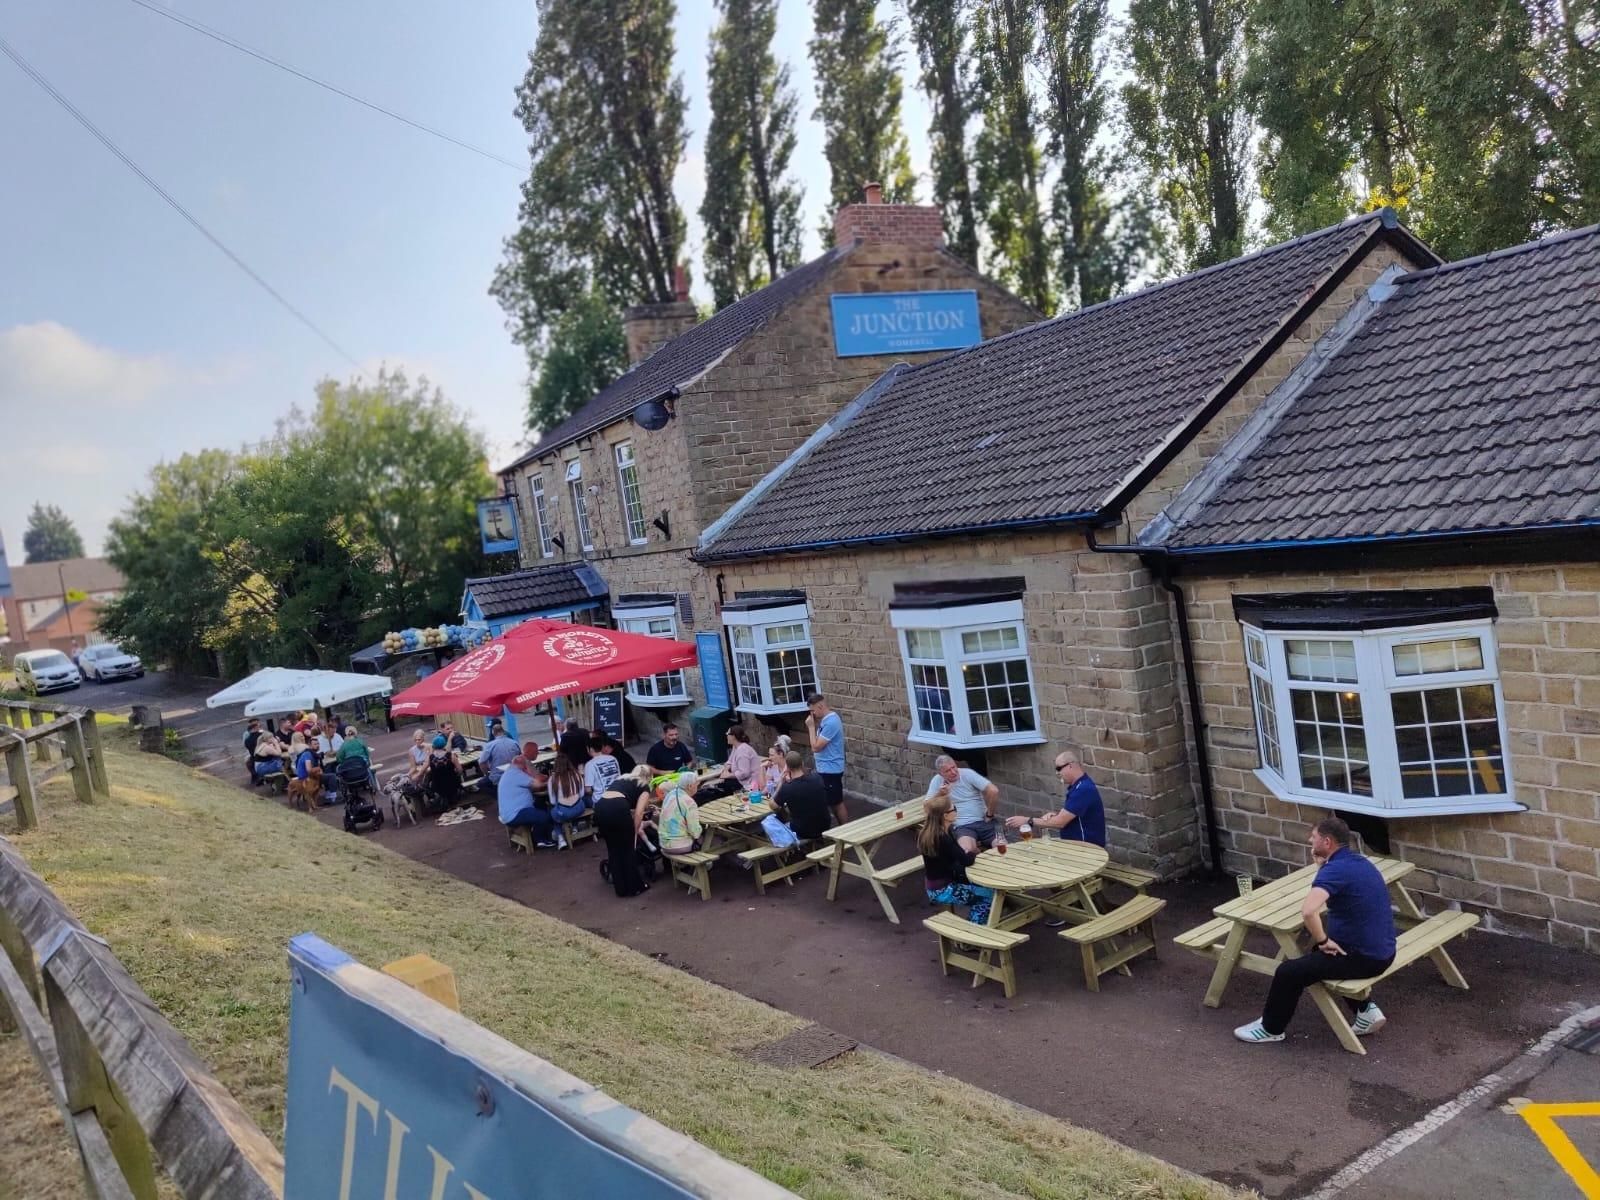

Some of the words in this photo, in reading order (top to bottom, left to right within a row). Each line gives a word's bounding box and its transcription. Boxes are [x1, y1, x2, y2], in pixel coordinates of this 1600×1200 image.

[894, 299, 920, 311] THE
[851, 310, 965, 335] JUNCTION
[516, 690, 544, 703] BIRRA
[543, 680, 580, 693] MORETTI
